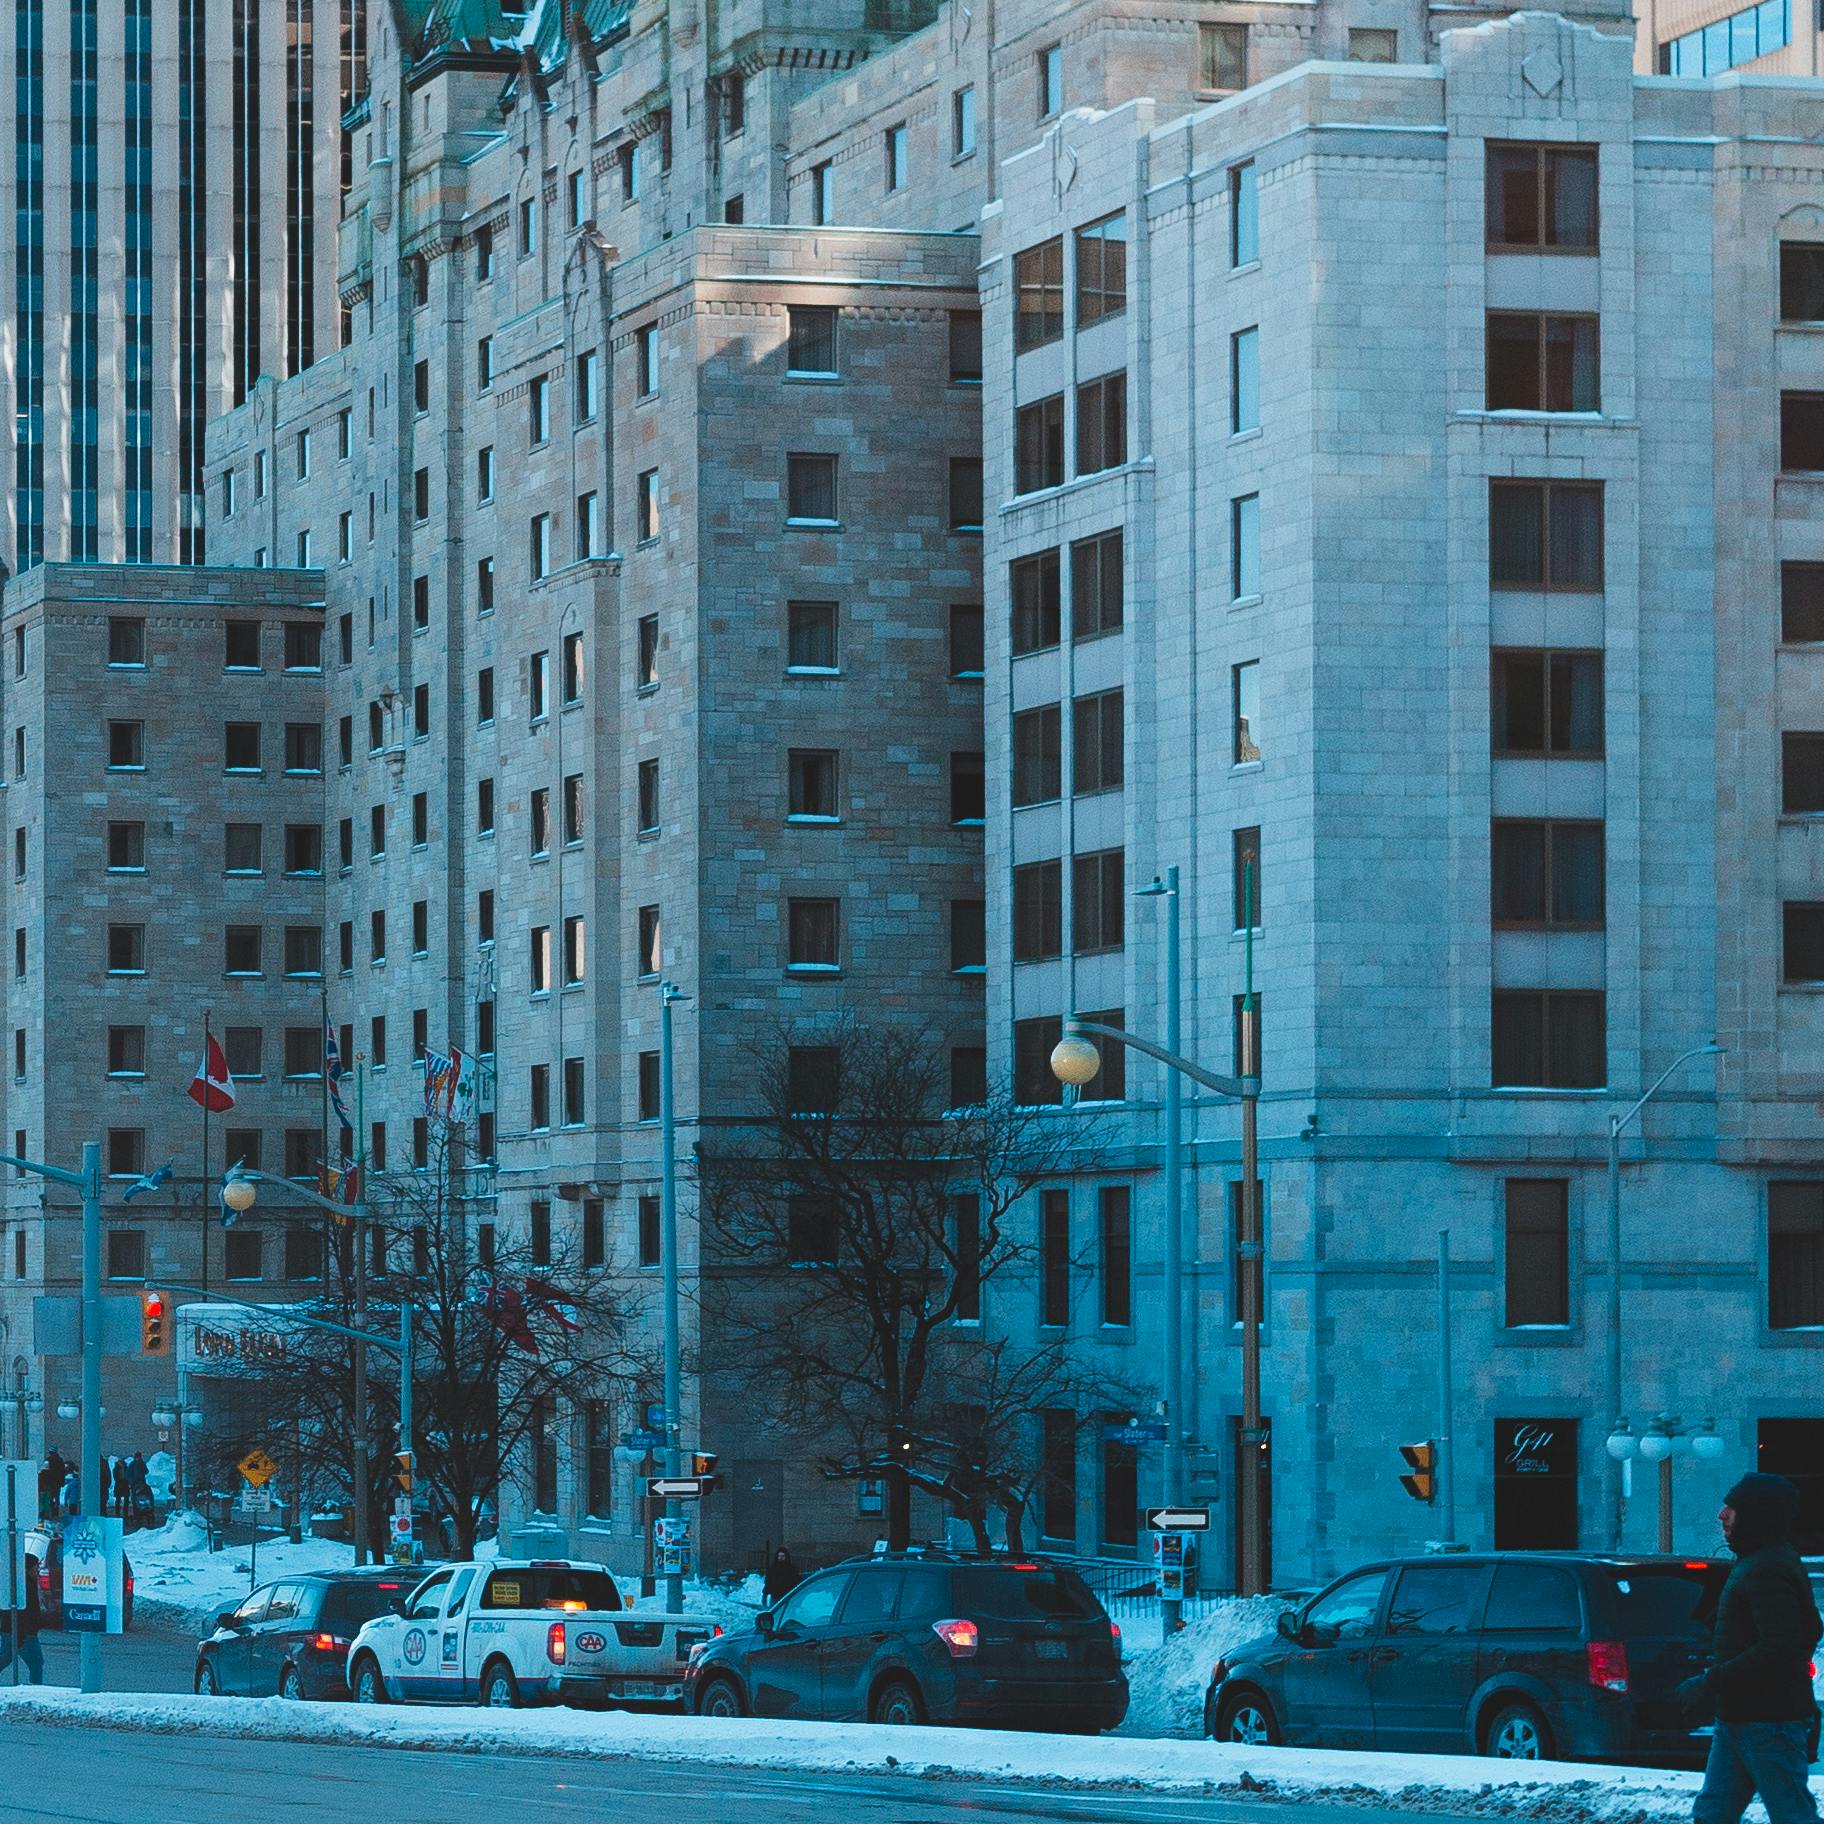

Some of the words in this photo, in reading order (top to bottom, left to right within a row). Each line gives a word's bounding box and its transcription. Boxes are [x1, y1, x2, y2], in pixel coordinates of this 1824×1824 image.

[1124, 1428, 1147, 1439] Slater
[69, 1608, 101, 1621] Canada
[406, 1633, 424, 1659] CAA
[579, 1634, 603, 1650] CAA
